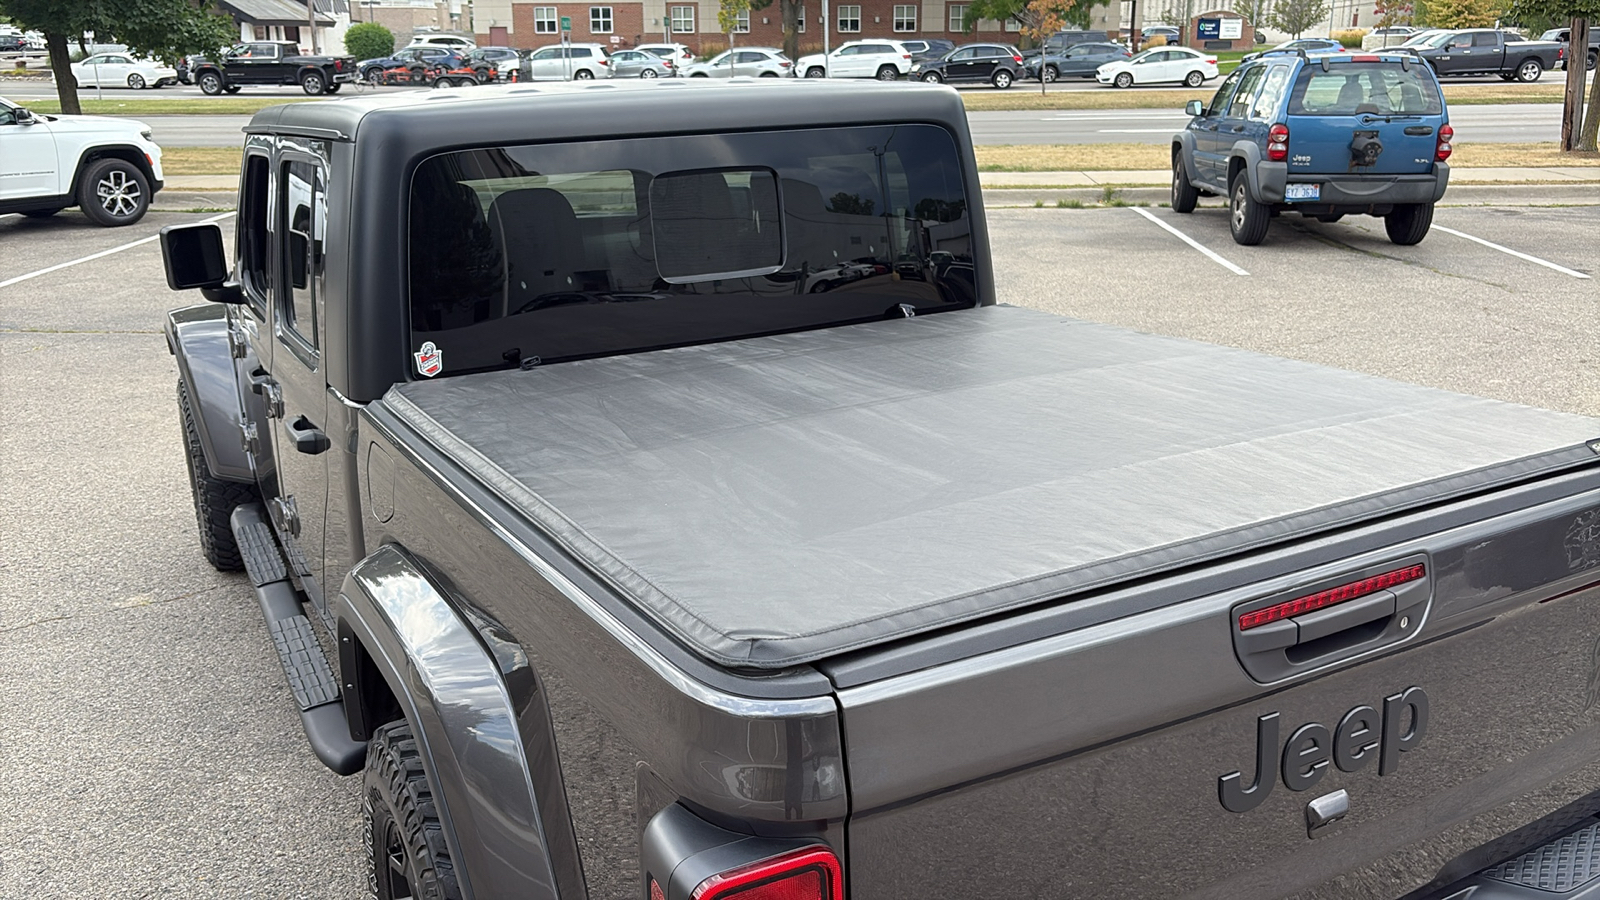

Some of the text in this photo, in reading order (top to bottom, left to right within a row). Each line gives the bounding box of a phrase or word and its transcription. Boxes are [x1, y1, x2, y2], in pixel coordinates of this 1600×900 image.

[1292, 154, 1311, 162] Jeep
[1286, 188, 1298, 197] EYZ
[1218, 685, 1429, 813] Jeep
